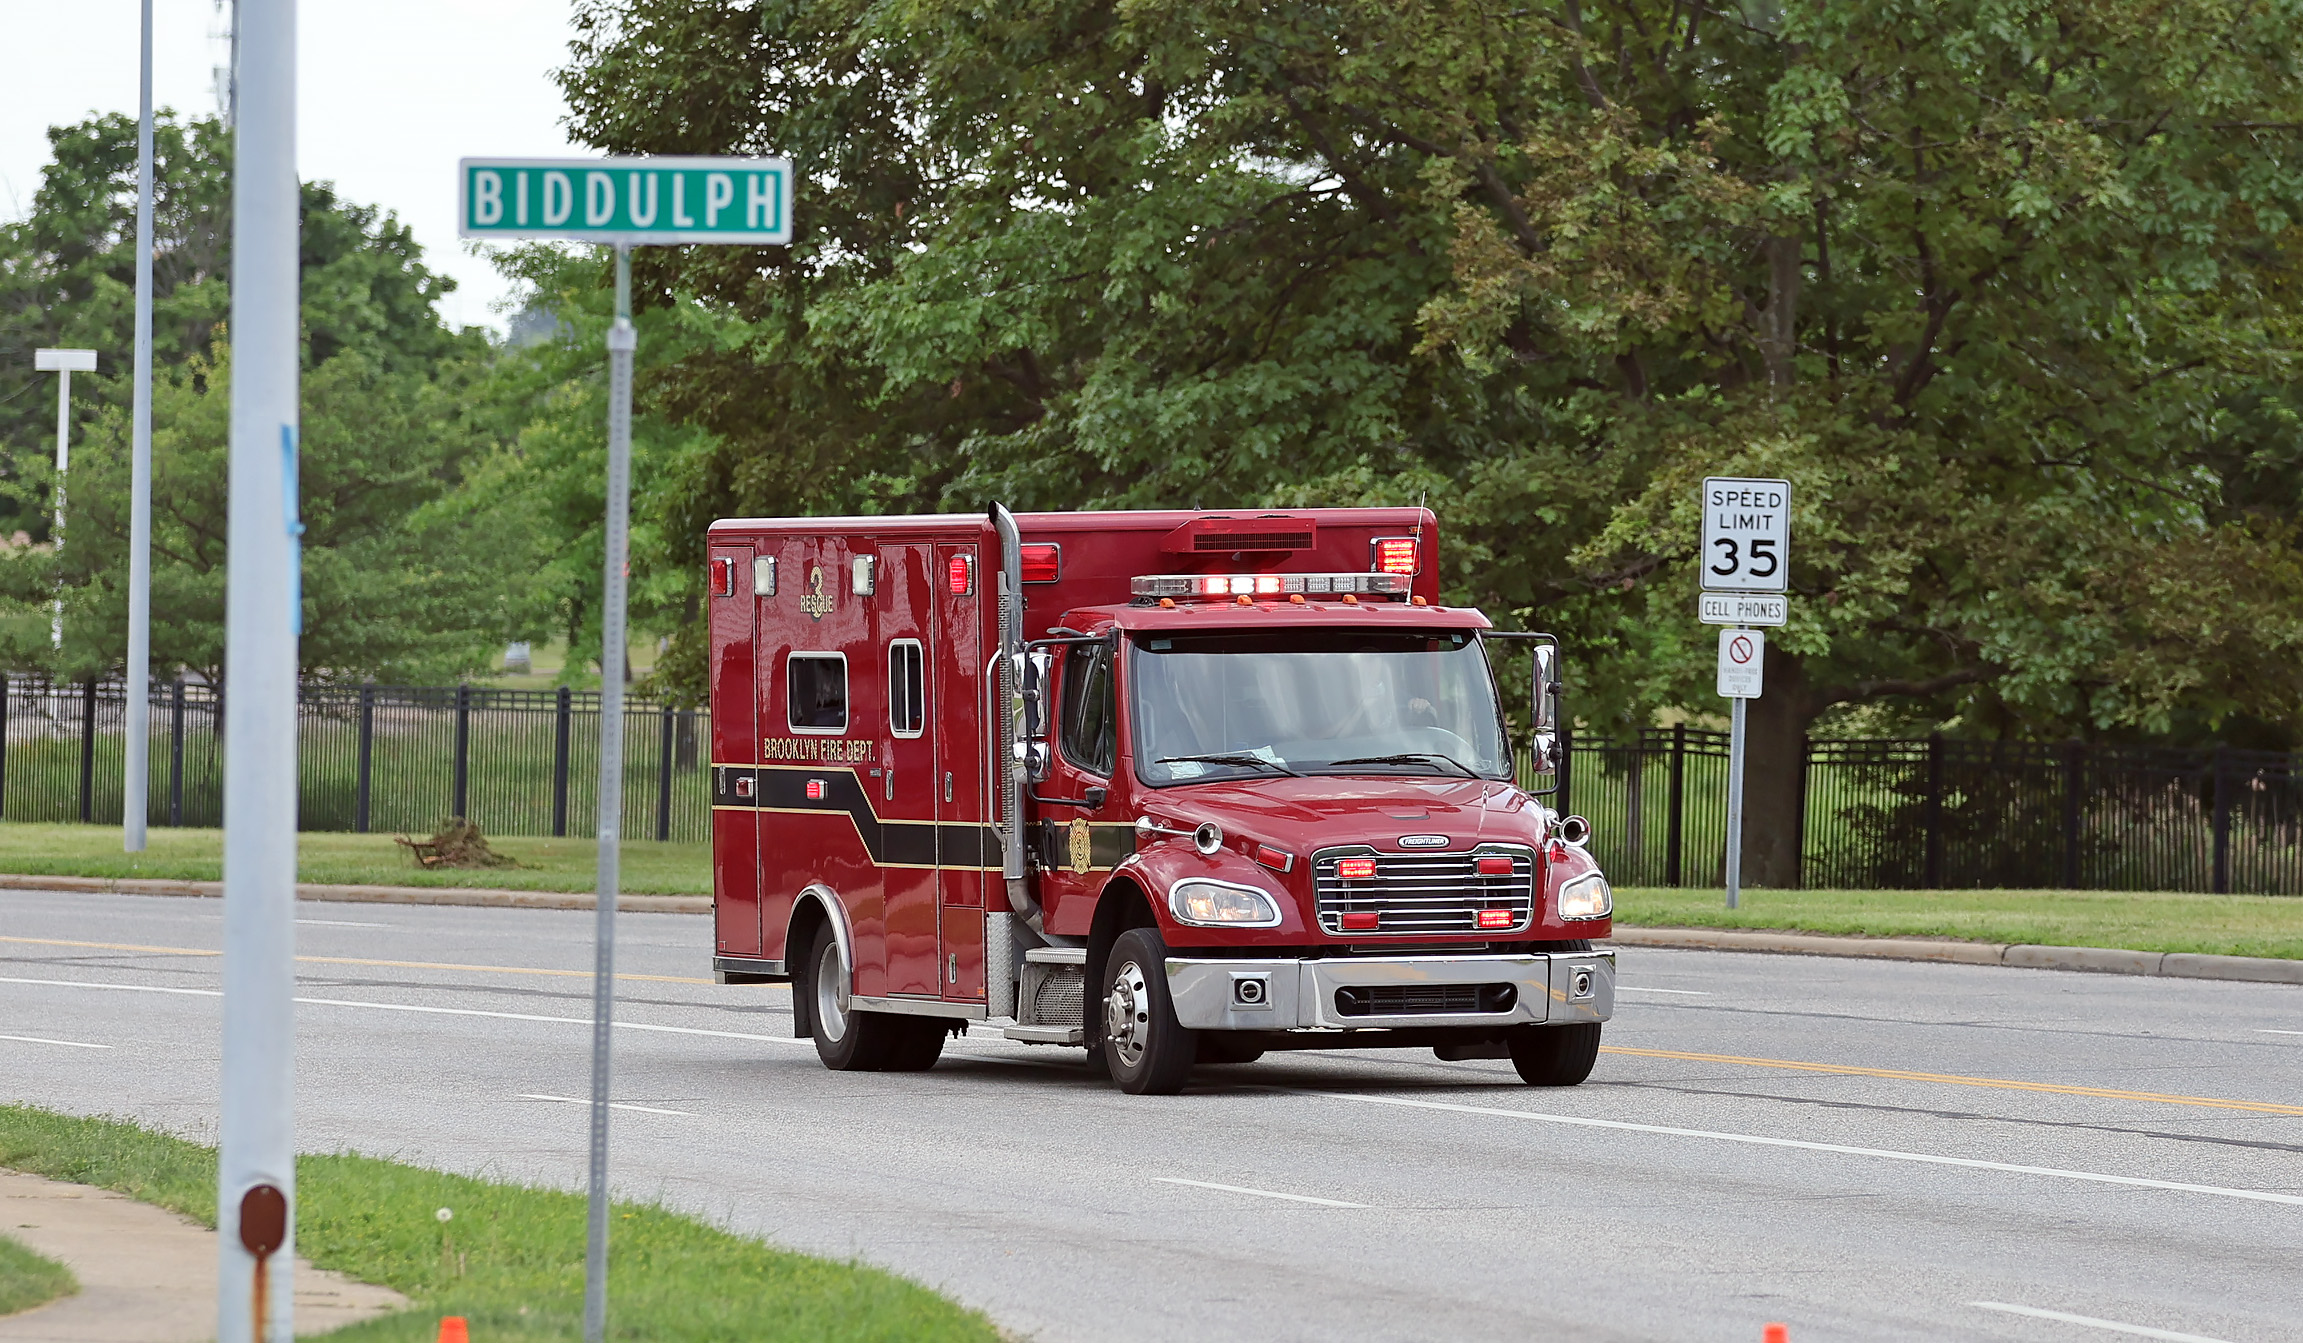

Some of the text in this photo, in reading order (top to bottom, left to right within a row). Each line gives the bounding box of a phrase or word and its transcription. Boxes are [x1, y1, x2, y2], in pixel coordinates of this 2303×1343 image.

[475, 171, 776, 229] BIDDULPH
[1712, 491, 1781, 508] SPEED
[1720, 513, 1773, 530] LIMIT
[1711, 538, 1777, 577] 35
[811, 566, 823, 618] 3
[800, 595, 834, 613] RESCUE
[1705, 601, 1781, 618] CELL PHONES
[764, 738, 876, 762] BROOKLYN FIRE DEPT.
